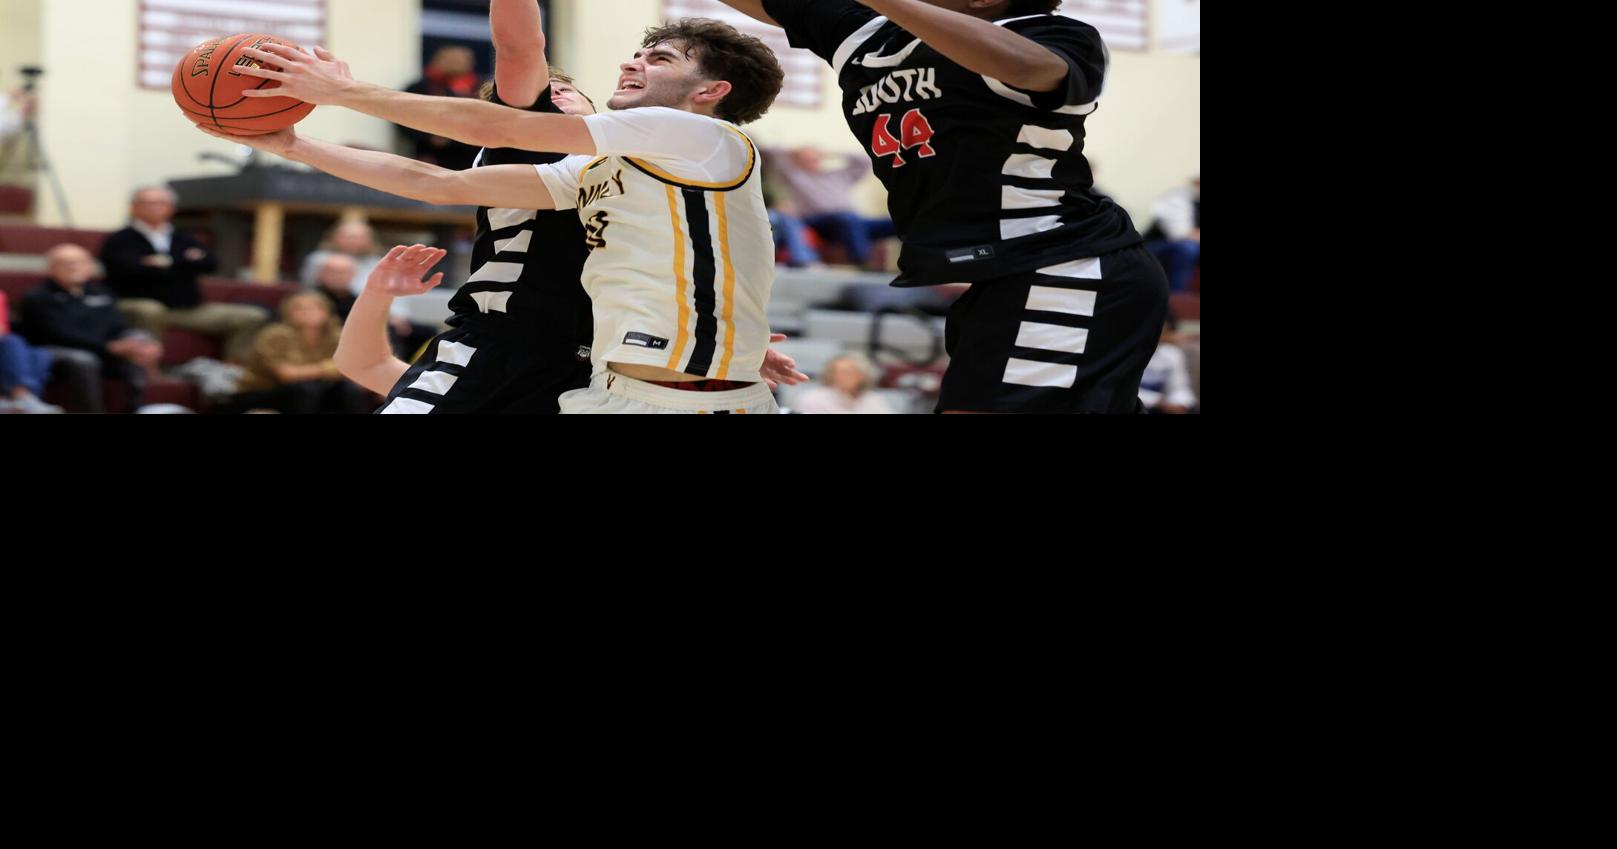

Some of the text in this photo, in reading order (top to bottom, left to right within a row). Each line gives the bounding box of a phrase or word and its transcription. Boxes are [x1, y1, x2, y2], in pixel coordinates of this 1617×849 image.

[852, 67, 942, 116] SOUTH
[872, 108, 936, 168] 44
[977, 248, 989, 256] XL
